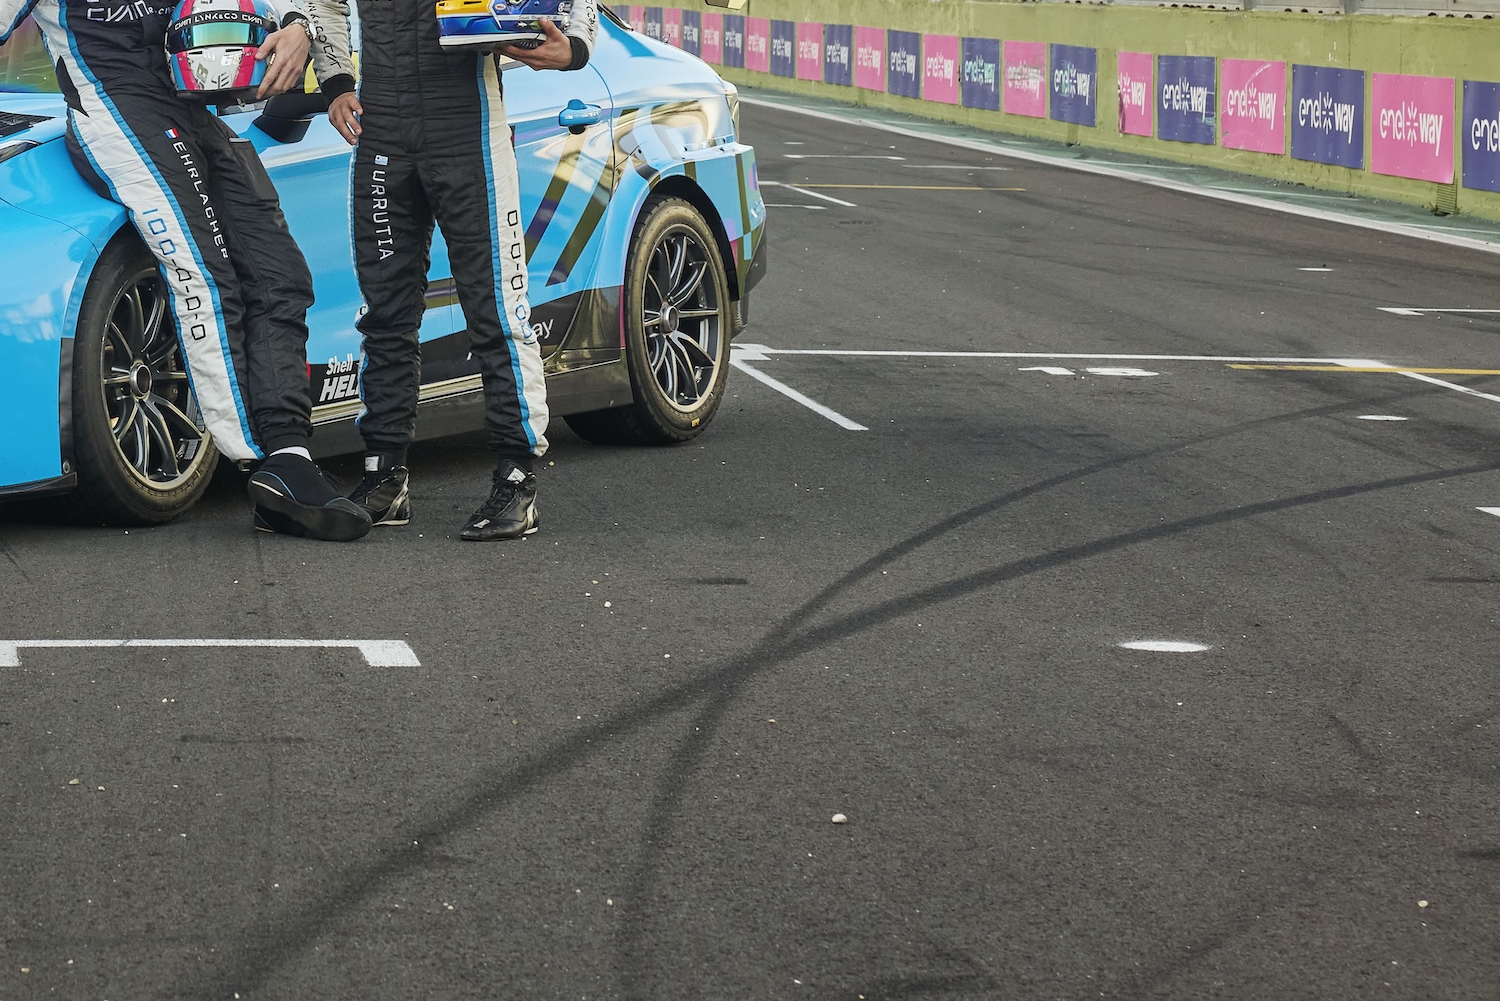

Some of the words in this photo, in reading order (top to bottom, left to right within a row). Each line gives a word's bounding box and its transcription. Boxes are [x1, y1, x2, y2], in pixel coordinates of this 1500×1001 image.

[1131, 81, 1146, 116] way
[1162, 79, 1182, 110] enel
[1190, 84, 1208, 119] way
[1227, 83, 1248, 117] enel
[1258, 92, 1277, 131] way
[1299, 92, 1322, 128] enel
[1334, 102, 1355, 144] way
[1379, 101, 1405, 140] enel
[1419, 112, 1443, 157] way
[172, 140, 229, 259] EHRLACHER
[371, 170, 395, 261] URRUTIA
[319, 373, 359, 402] HEL
[326, 352, 354, 376] Shell
